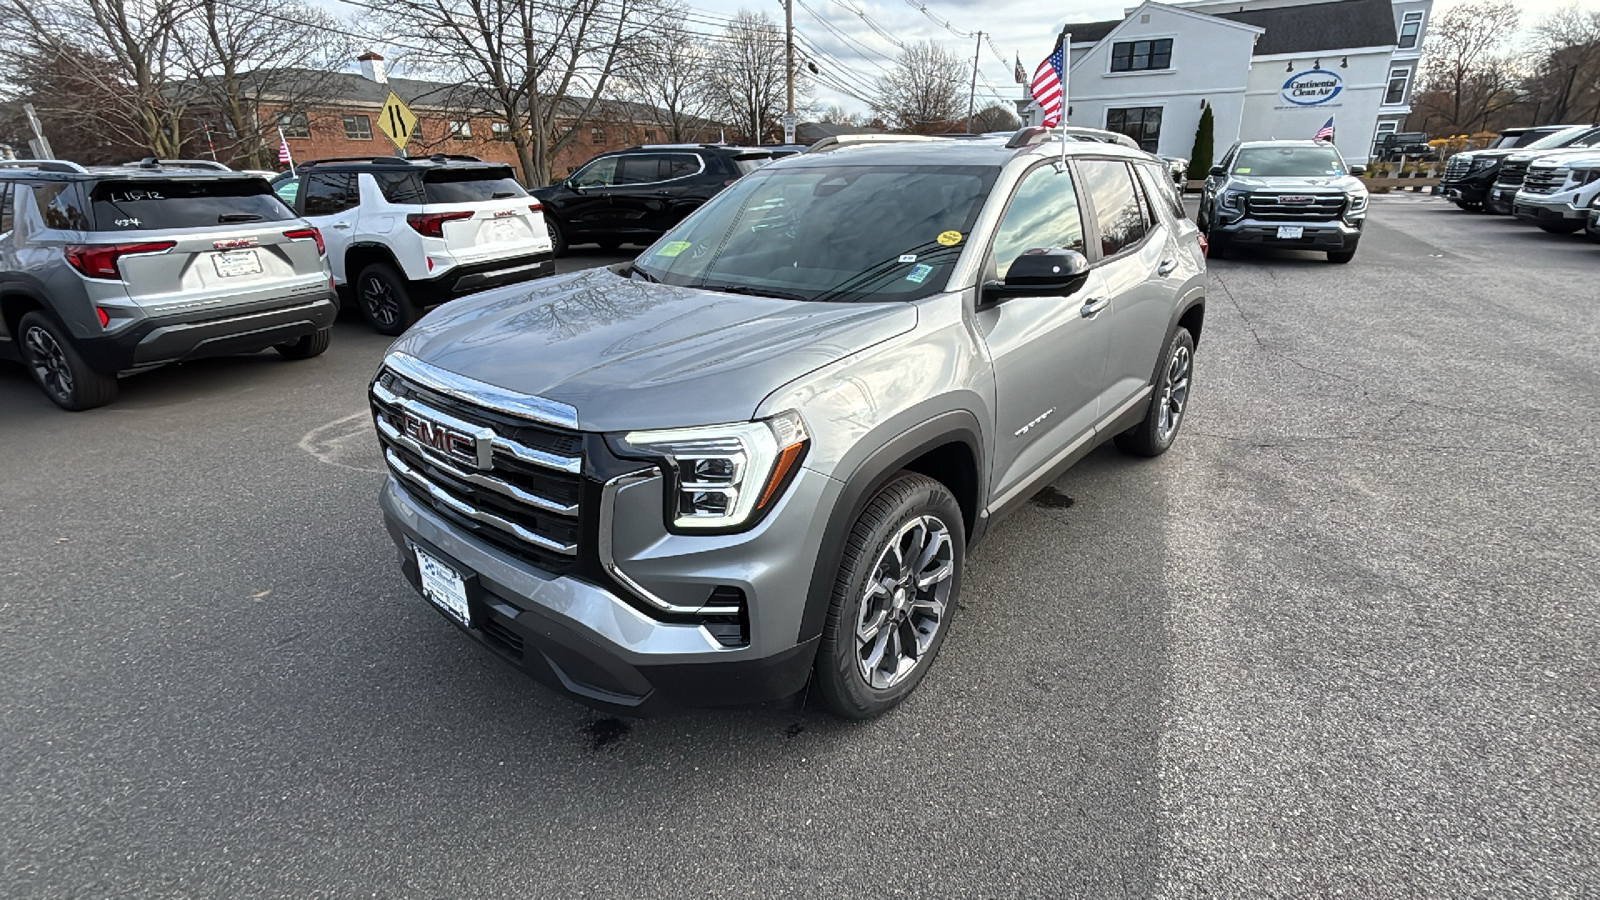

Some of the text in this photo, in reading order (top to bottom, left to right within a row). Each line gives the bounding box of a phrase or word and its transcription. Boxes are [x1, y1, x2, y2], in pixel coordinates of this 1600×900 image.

[1290, 79, 1337, 89] Continental
[1292, 87, 1333, 97] Clean Air
[402, 410, 477, 465] GMC
